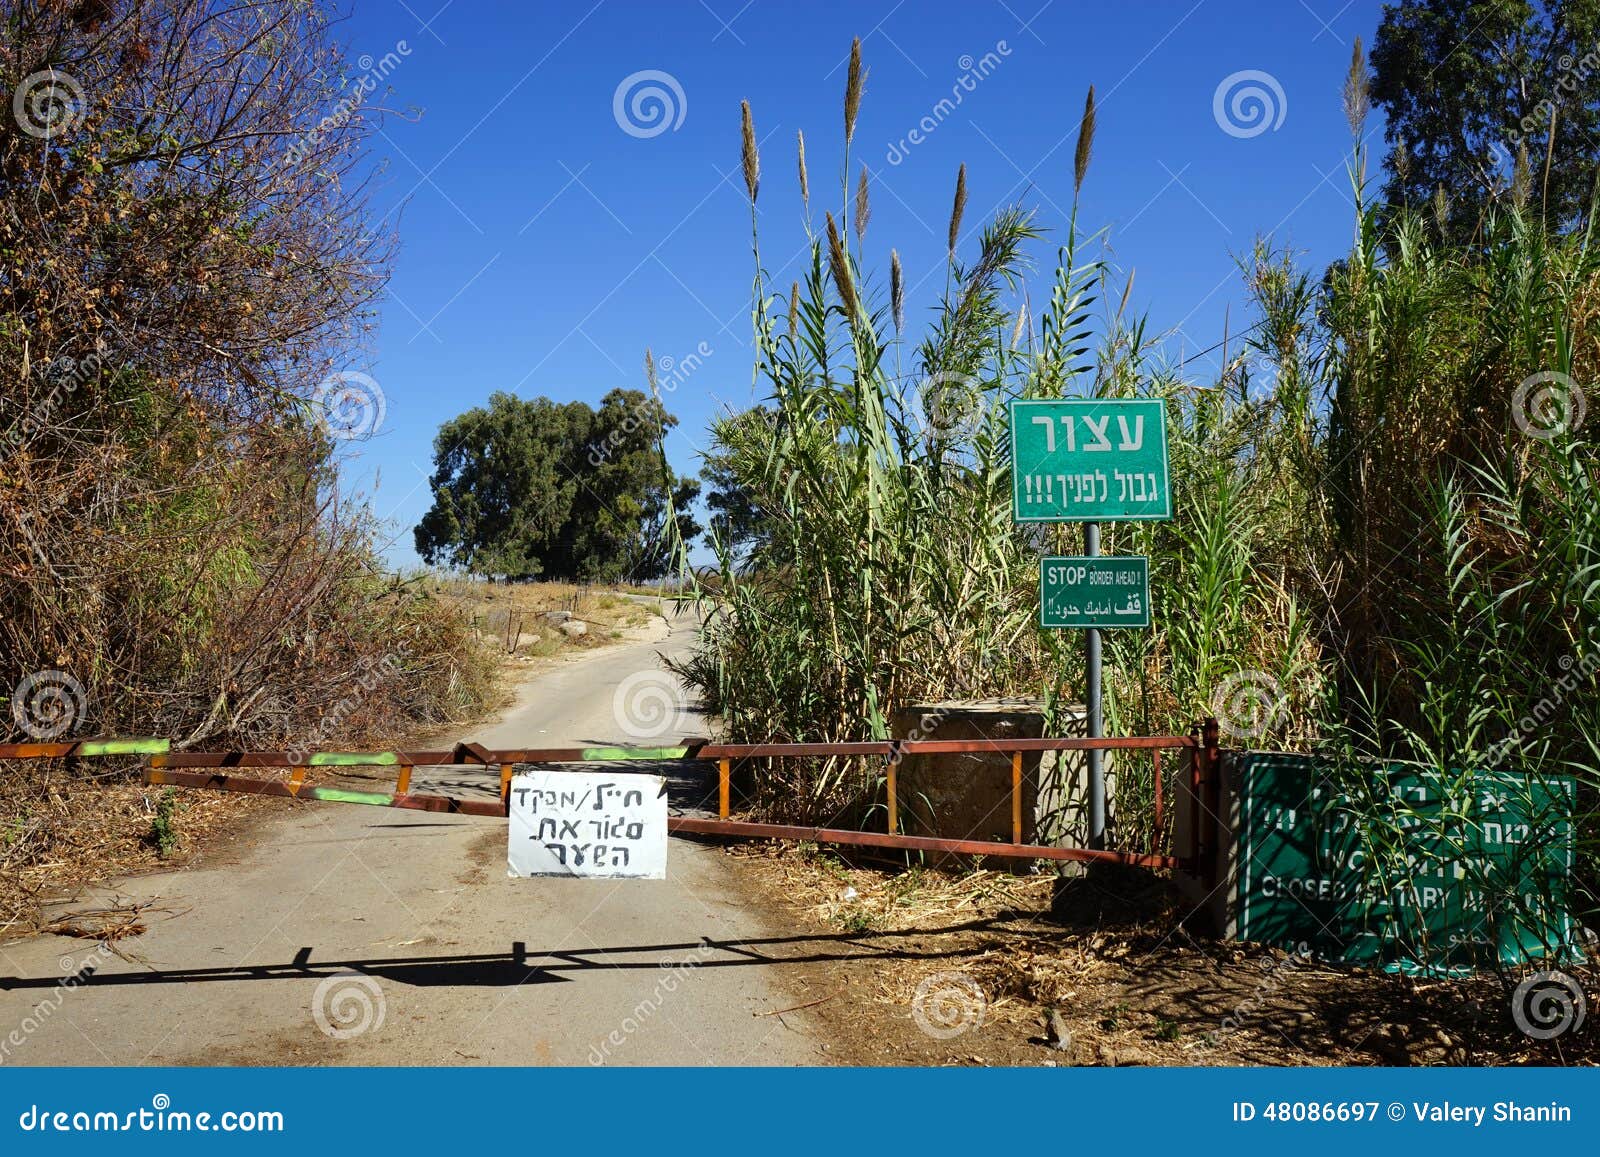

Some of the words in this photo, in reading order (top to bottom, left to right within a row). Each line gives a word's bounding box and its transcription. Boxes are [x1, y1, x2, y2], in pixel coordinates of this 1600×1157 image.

[1031, 415, 1144, 452] עצור
[1114, 468, 1158, 502] גבול
[1048, 566, 1086, 585] STOP
[1089, 571, 1114, 585] BORDER
[1083, 598, 1111, 615] أمامك
[1114, 592, 1142, 615] قف
[529, 817, 581, 840] את
[589, 815, 643, 840] סגור
[544, 843, 629, 866] השער
[1261, 875, 1347, 901] CLOSED
